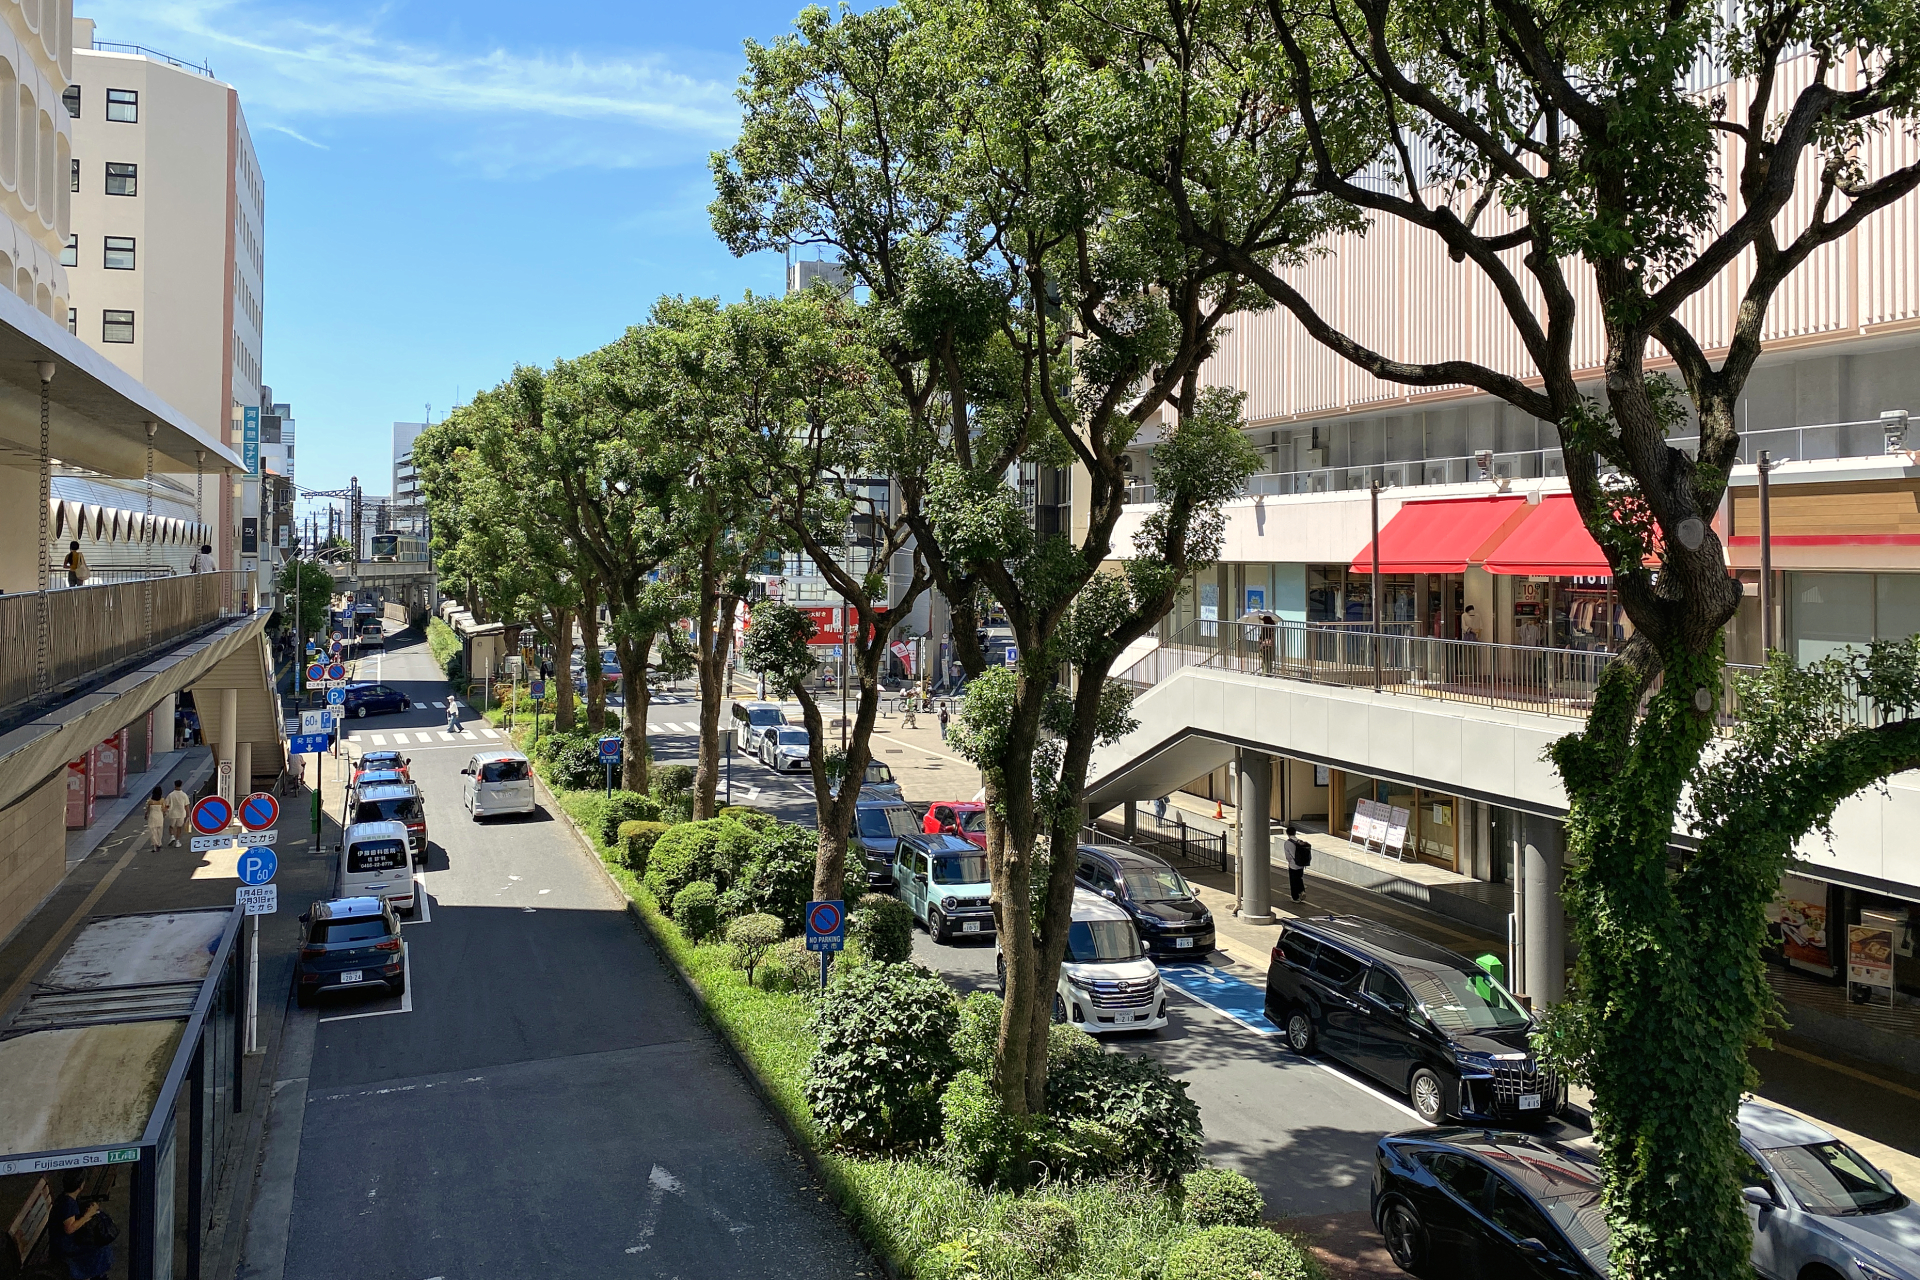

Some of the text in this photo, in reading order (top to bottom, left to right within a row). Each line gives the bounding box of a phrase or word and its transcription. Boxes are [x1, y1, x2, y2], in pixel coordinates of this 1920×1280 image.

[323, 712, 330, 723] P
[193, 838, 231, 849] ここまで
[240, 833, 276, 844] ここから
[246, 857, 262, 882] P
[818, 935, 841, 943] PARKING
[34, 1155, 102, 1170] Fujisawa Sta.
